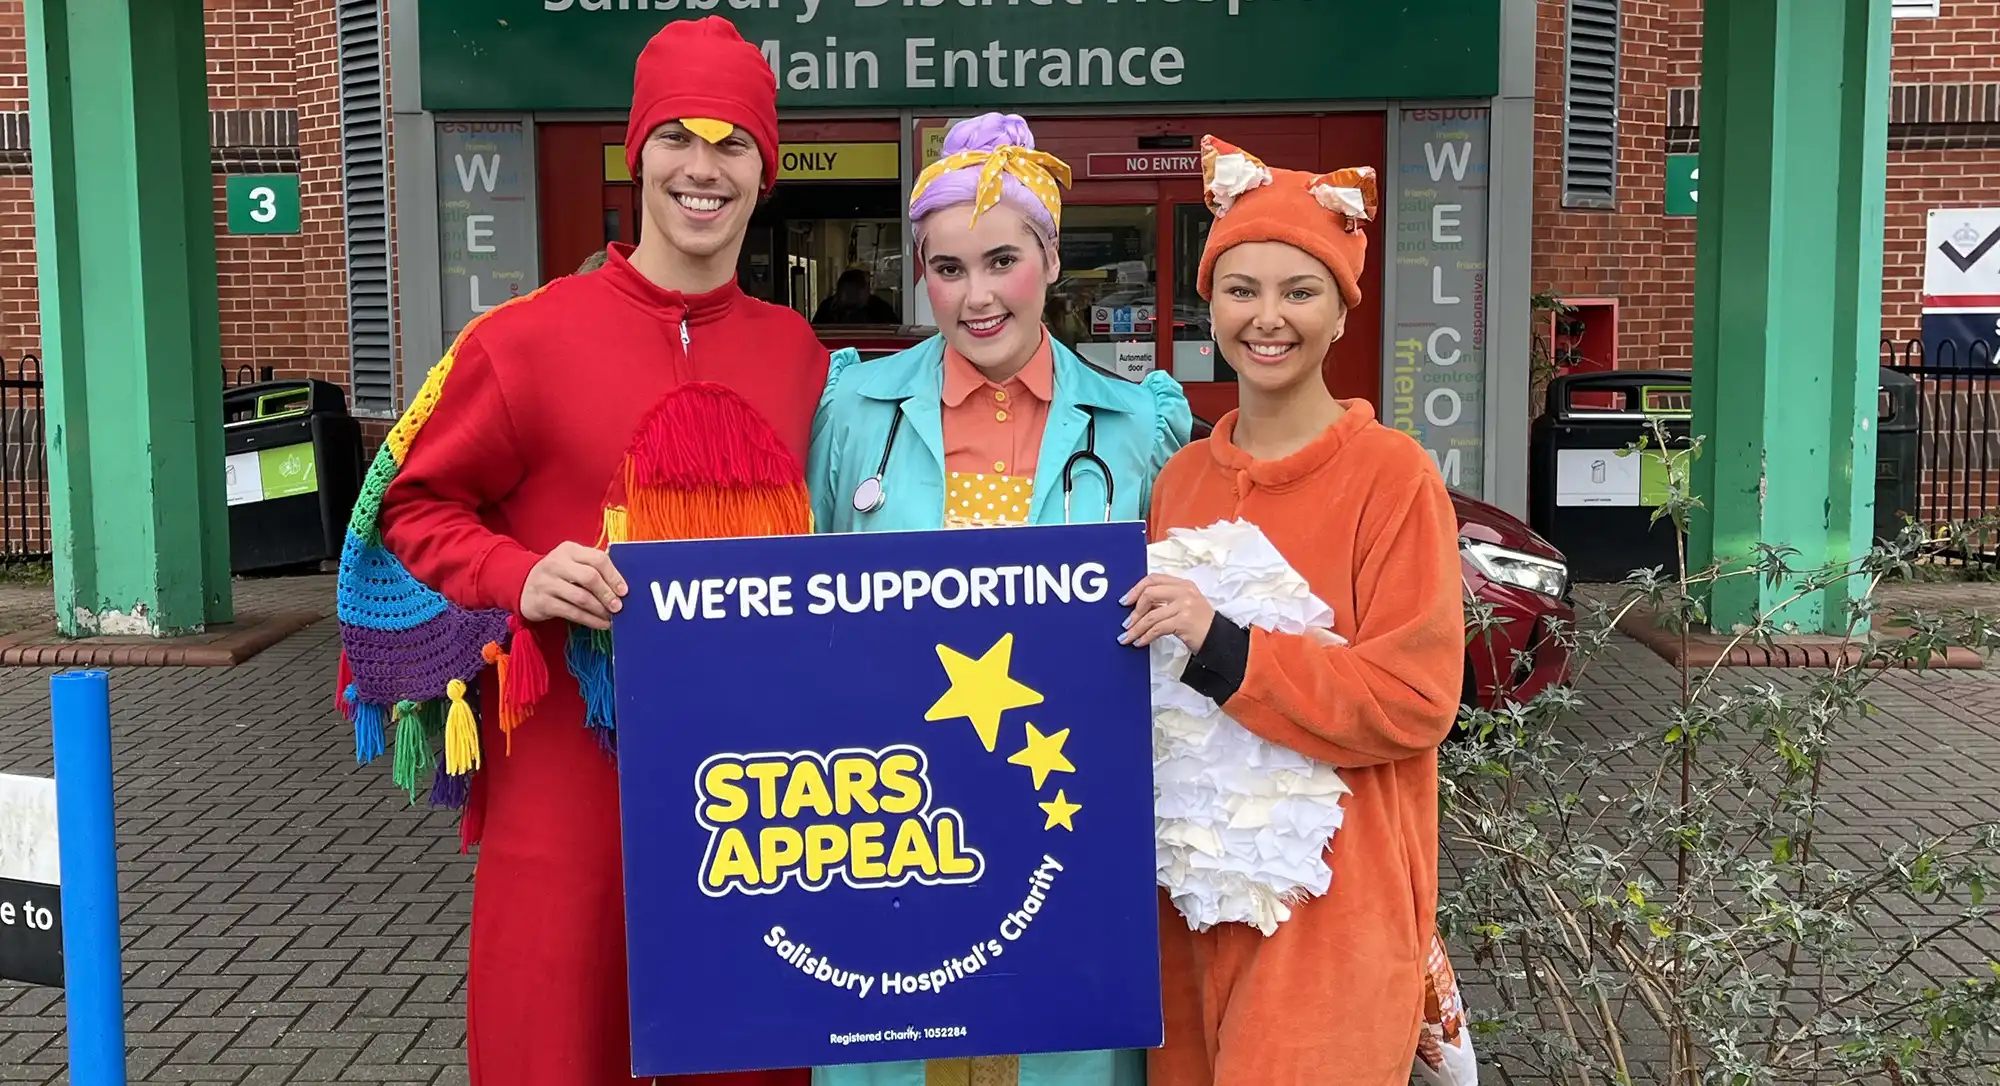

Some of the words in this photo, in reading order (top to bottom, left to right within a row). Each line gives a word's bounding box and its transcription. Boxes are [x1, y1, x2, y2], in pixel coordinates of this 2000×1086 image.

[905, 37, 1185, 88] Entrance
[782, 151, 838, 172] ONLY
[1126, 157, 1149, 171] NO
[1152, 156, 1198, 170] ENTRY
[248, 186, 277, 223] 3
[1472, 273, 1484, 351] responsive
[1119, 353, 1152, 362] Automatic
[1128, 363, 1144, 372] door
[1394, 338, 1423, 442] friend
[650, 576, 793, 621] WE'RE
[806, 562, 1109, 616] SUPPORTING
[704, 753, 923, 823] STARS
[708, 817, 975, 887] APPEAL
[22, 900, 53, 931] to
[763, 925, 875, 999] Salisbury
[881, 938, 1003, 995] Hospital's
[999, 853, 1064, 941] Charity
[829, 1031, 882, 1046] Registered
[883, 1026, 922, 1041] Charity:
[923, 1026, 968, 1039] 1052284
